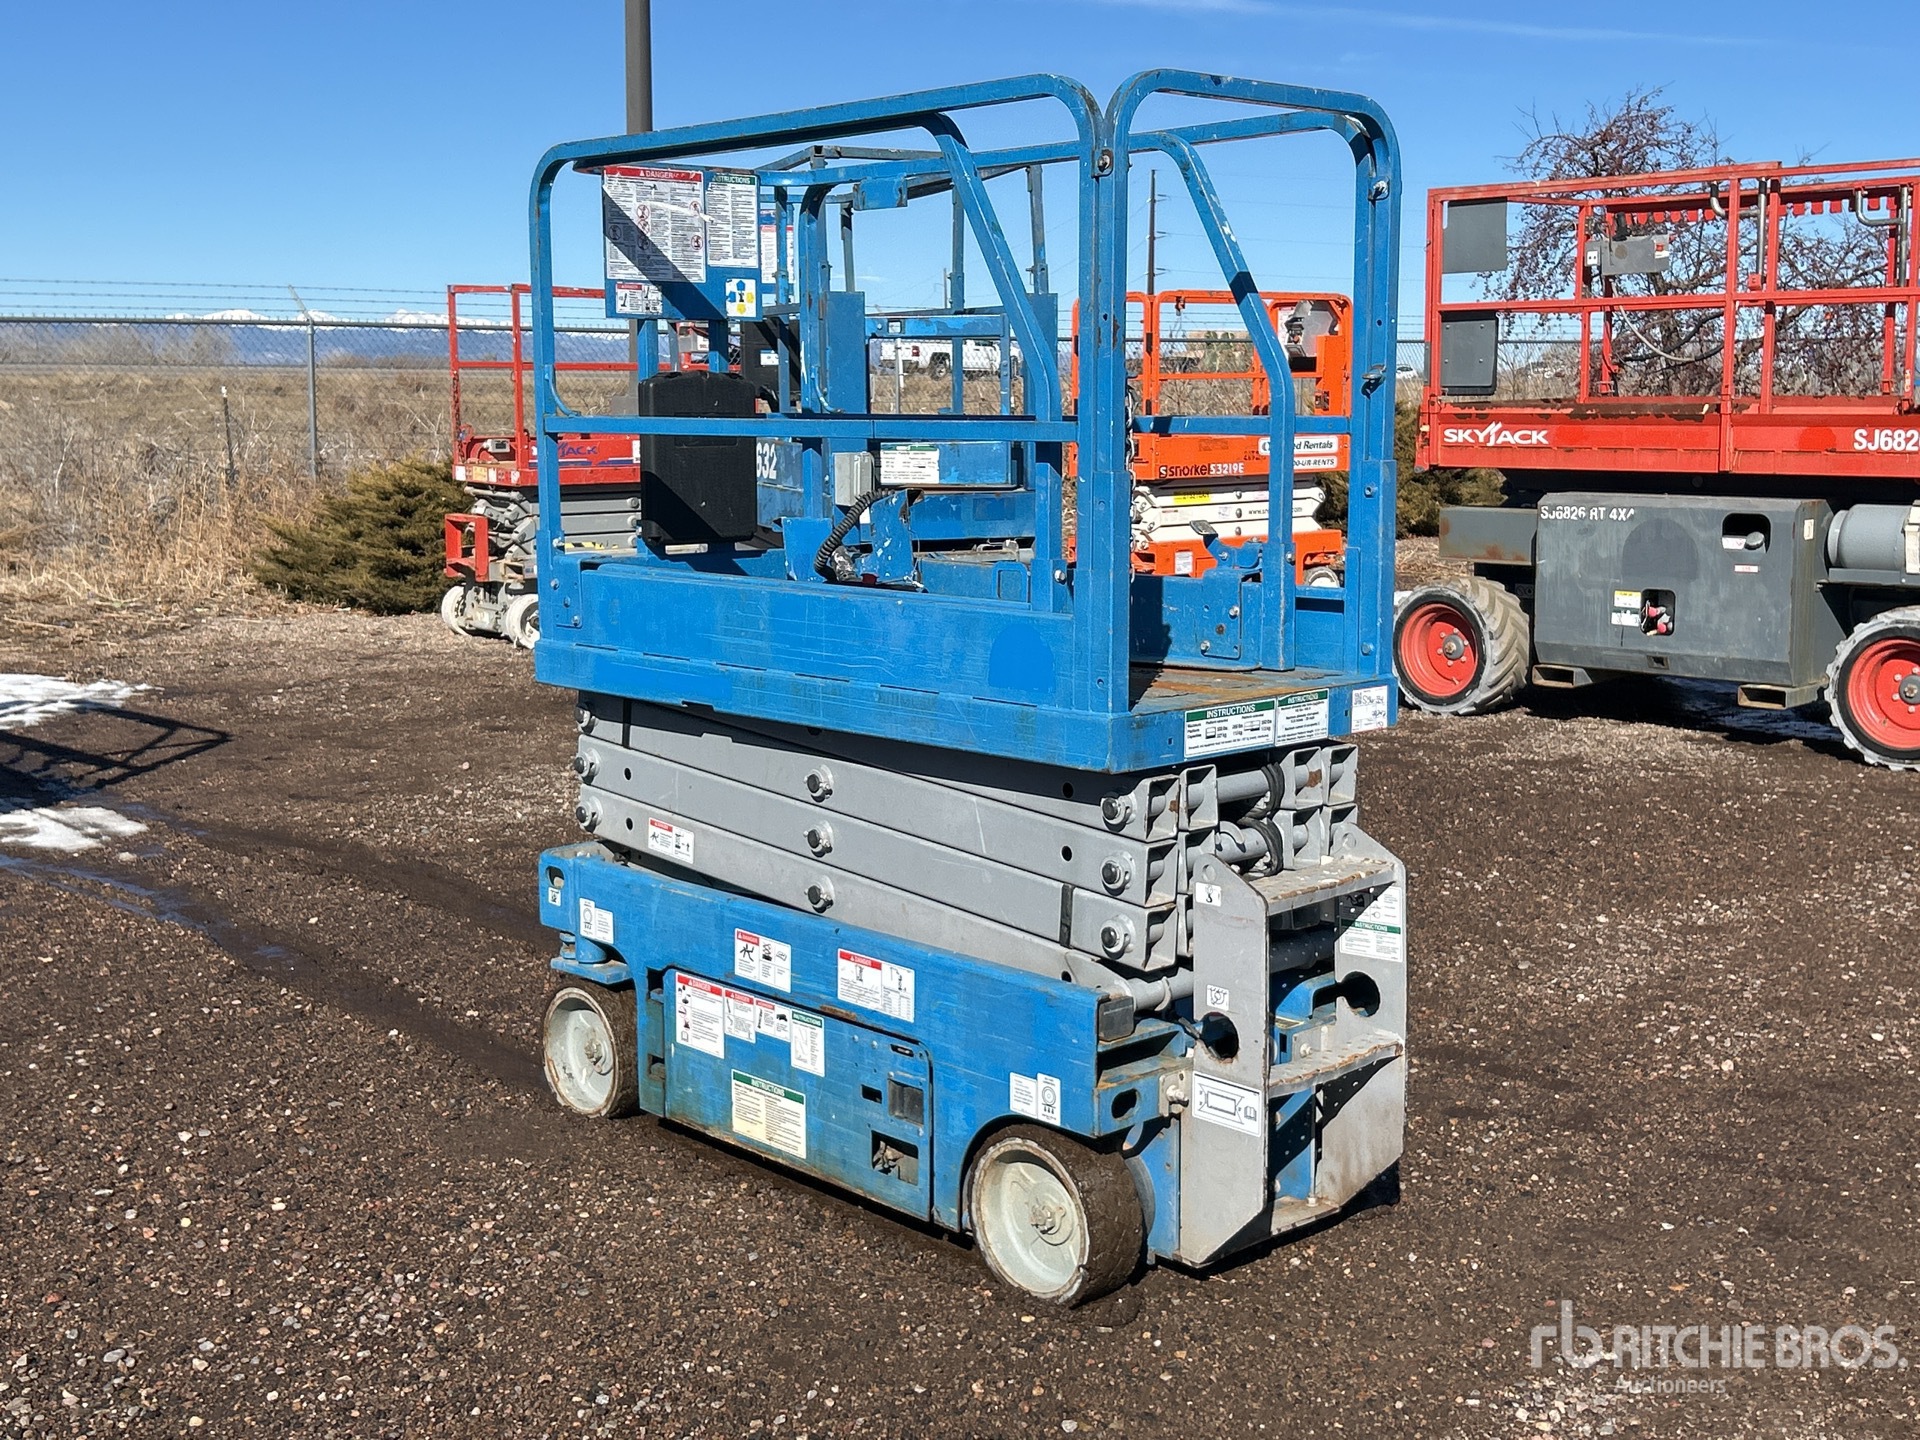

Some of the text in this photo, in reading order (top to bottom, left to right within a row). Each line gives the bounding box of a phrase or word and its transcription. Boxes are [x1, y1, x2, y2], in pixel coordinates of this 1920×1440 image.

[645, 170, 673, 179] DANGER
[1443, 421, 1549, 447] SKYJACK
[1853, 428, 1920, 451] SJ682
[1303, 440, 1333, 449] Rentals
[1210, 458, 1245, 475] S3219E
[1206, 703, 1256, 719] INSTRUCTIONS
[751, 1079, 785, 1097] INSTRUCTIONS
